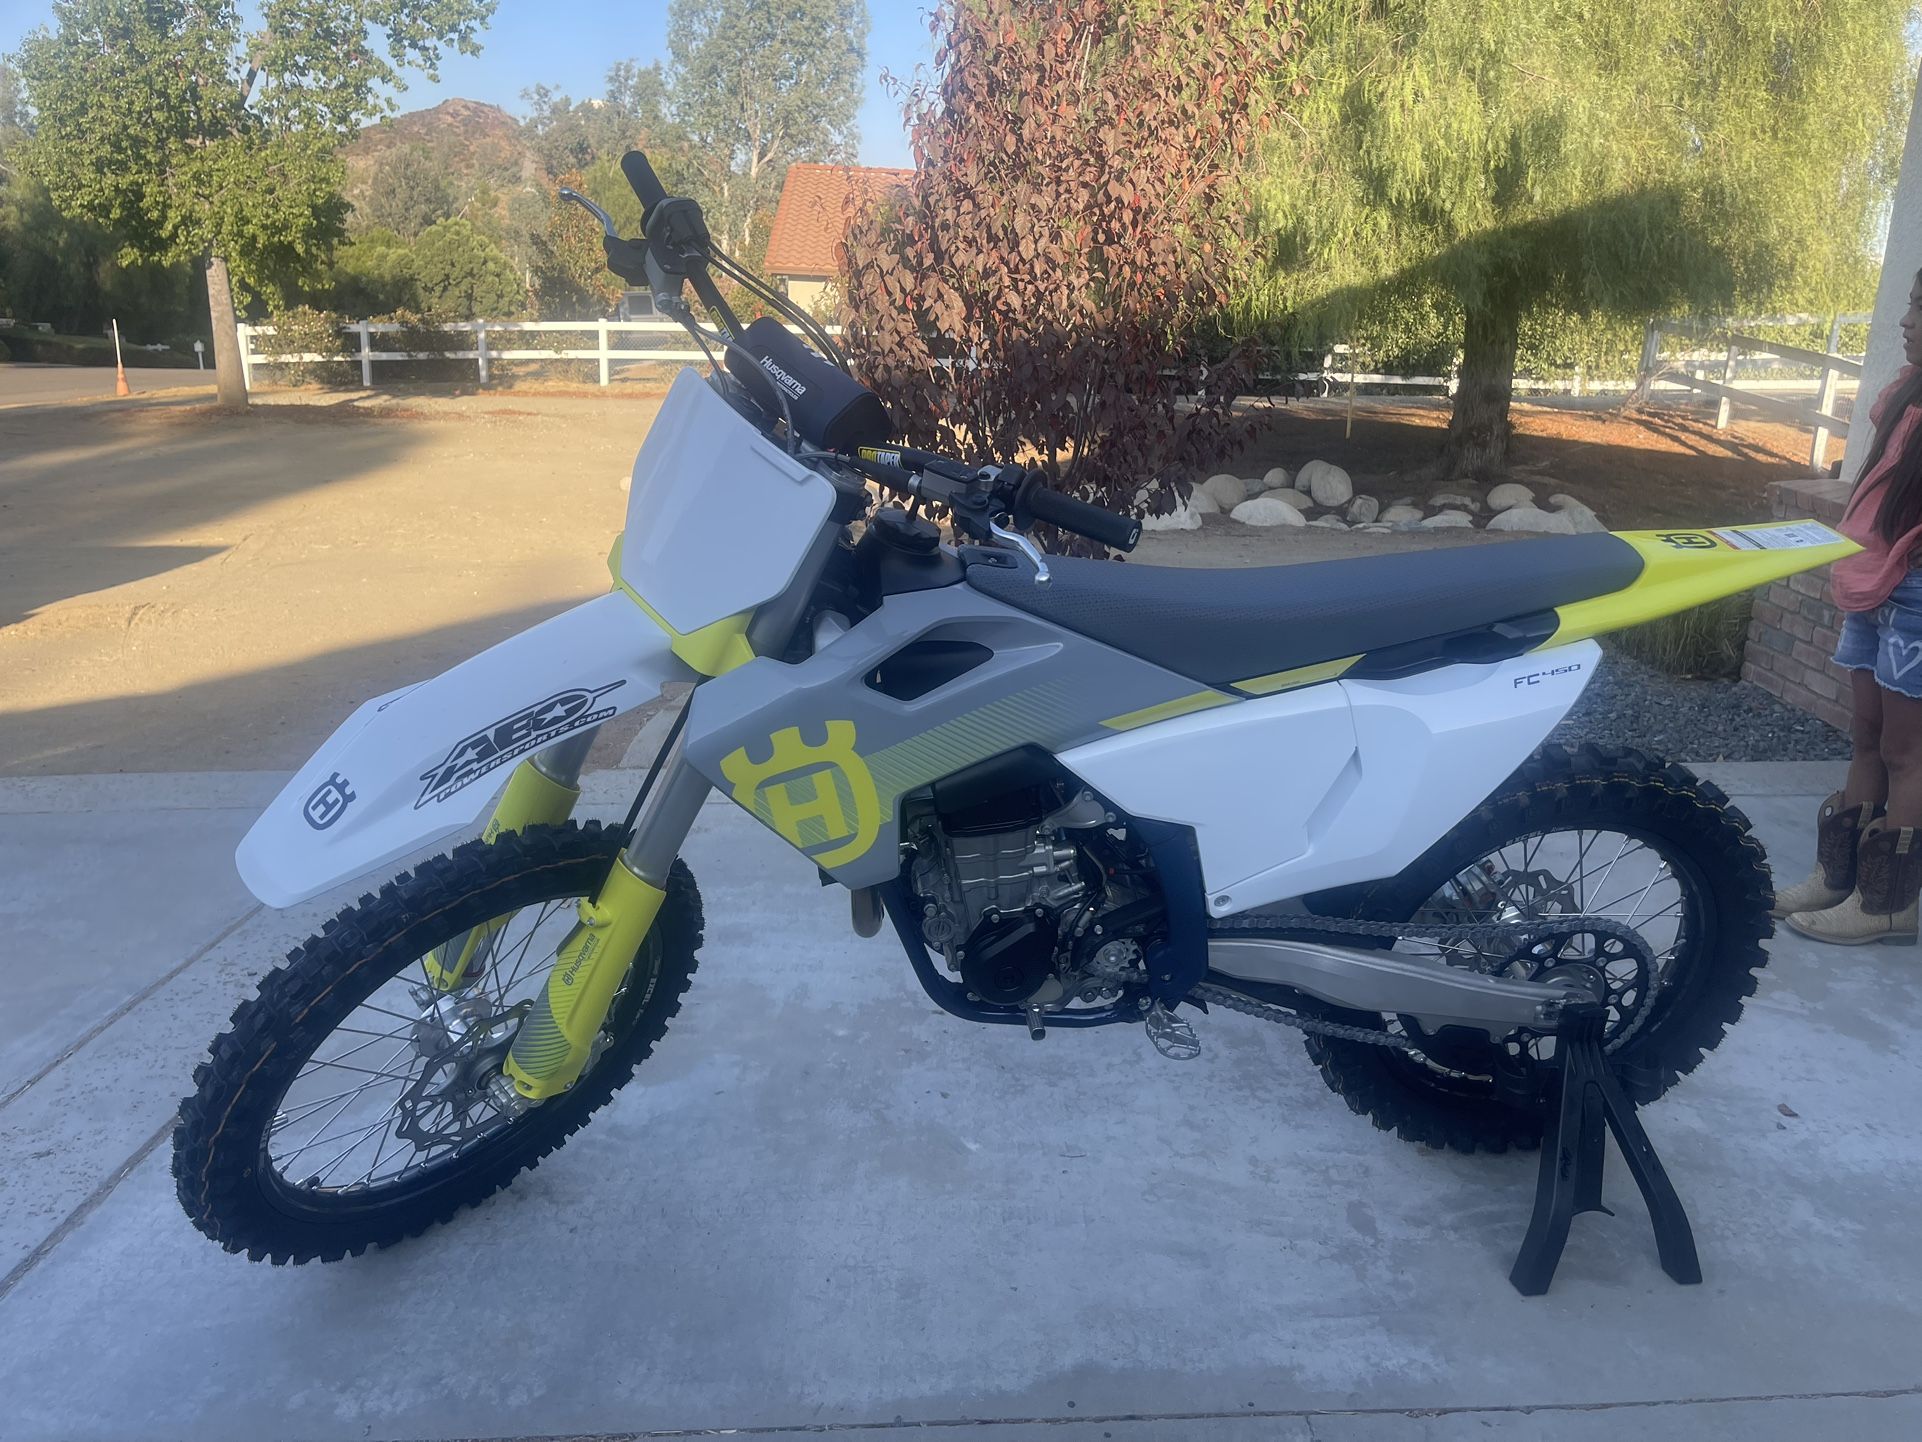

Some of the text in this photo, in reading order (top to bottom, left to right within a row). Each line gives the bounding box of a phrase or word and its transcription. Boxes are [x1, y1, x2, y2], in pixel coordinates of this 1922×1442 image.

[760, 355, 806, 396] Husqvarna
[1513, 663, 1581, 688] FC 450
[440, 707, 615, 800] POWERSPORTS.COM
[570, 933, 596, 977] Husqvarna
